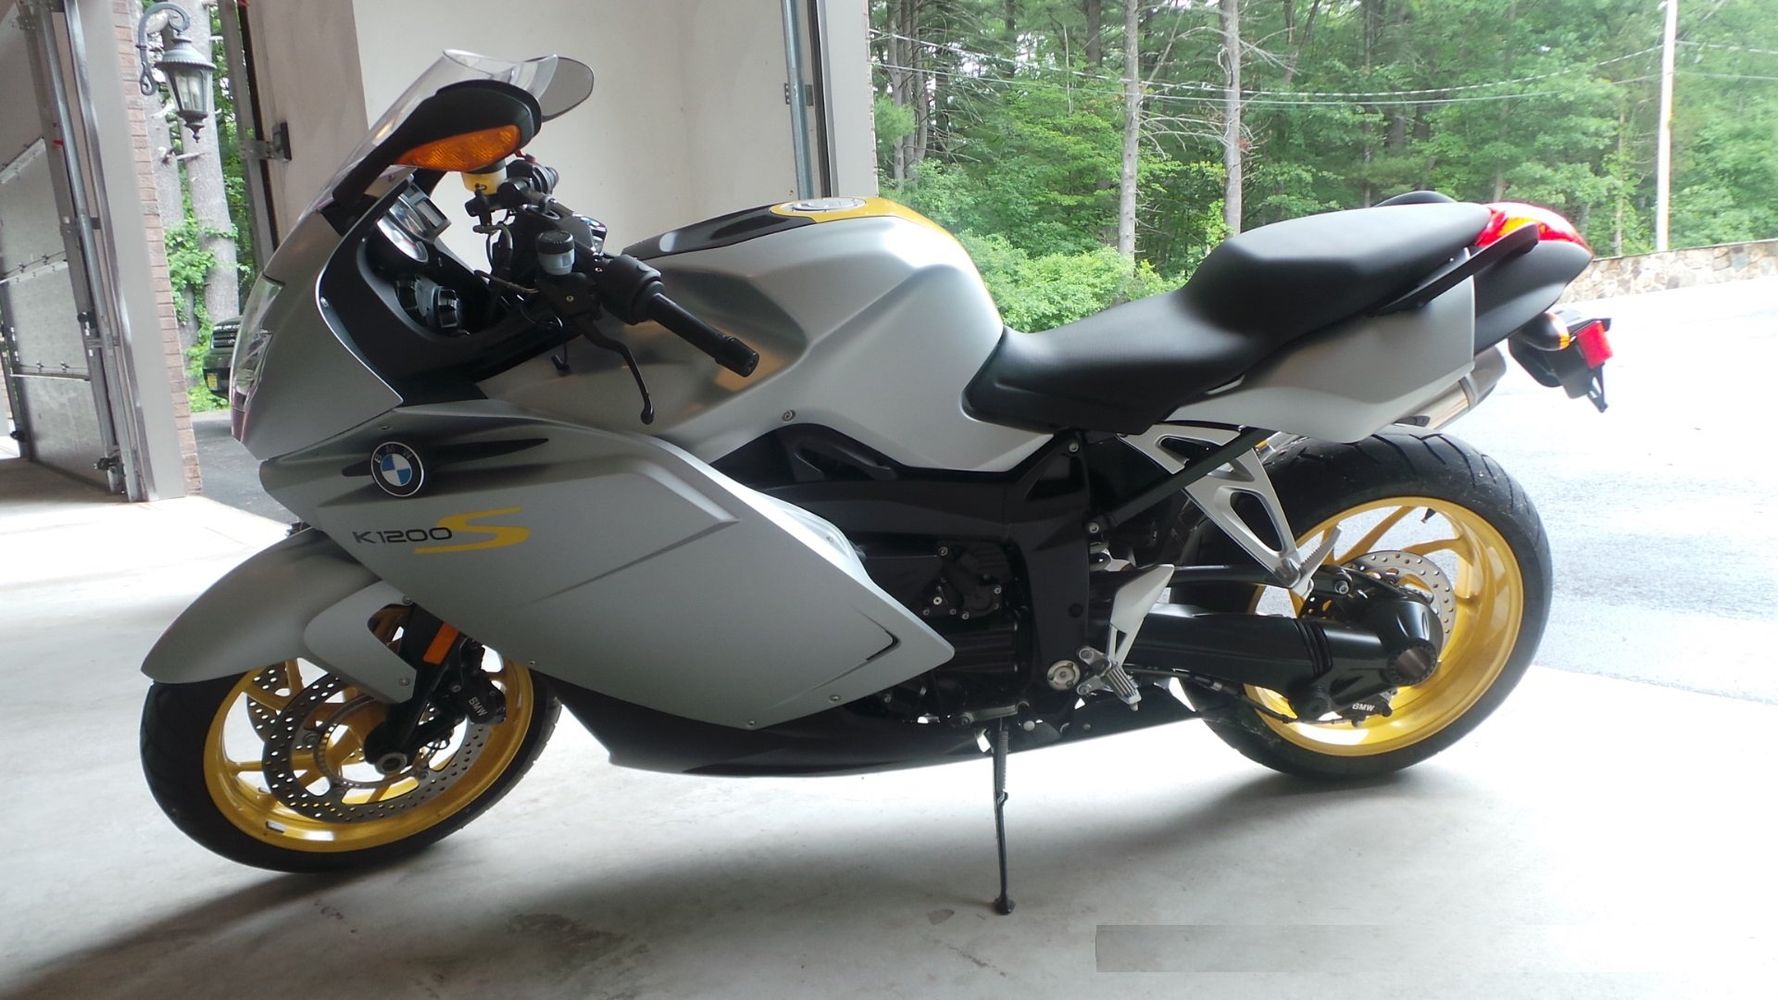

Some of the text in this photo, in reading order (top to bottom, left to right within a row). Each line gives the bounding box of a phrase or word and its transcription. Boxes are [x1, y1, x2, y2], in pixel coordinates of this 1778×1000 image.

[374, 445, 414, 464] BMW
[468, 696, 488, 716] BMW
[1352, 702, 1375, 712] BMW
